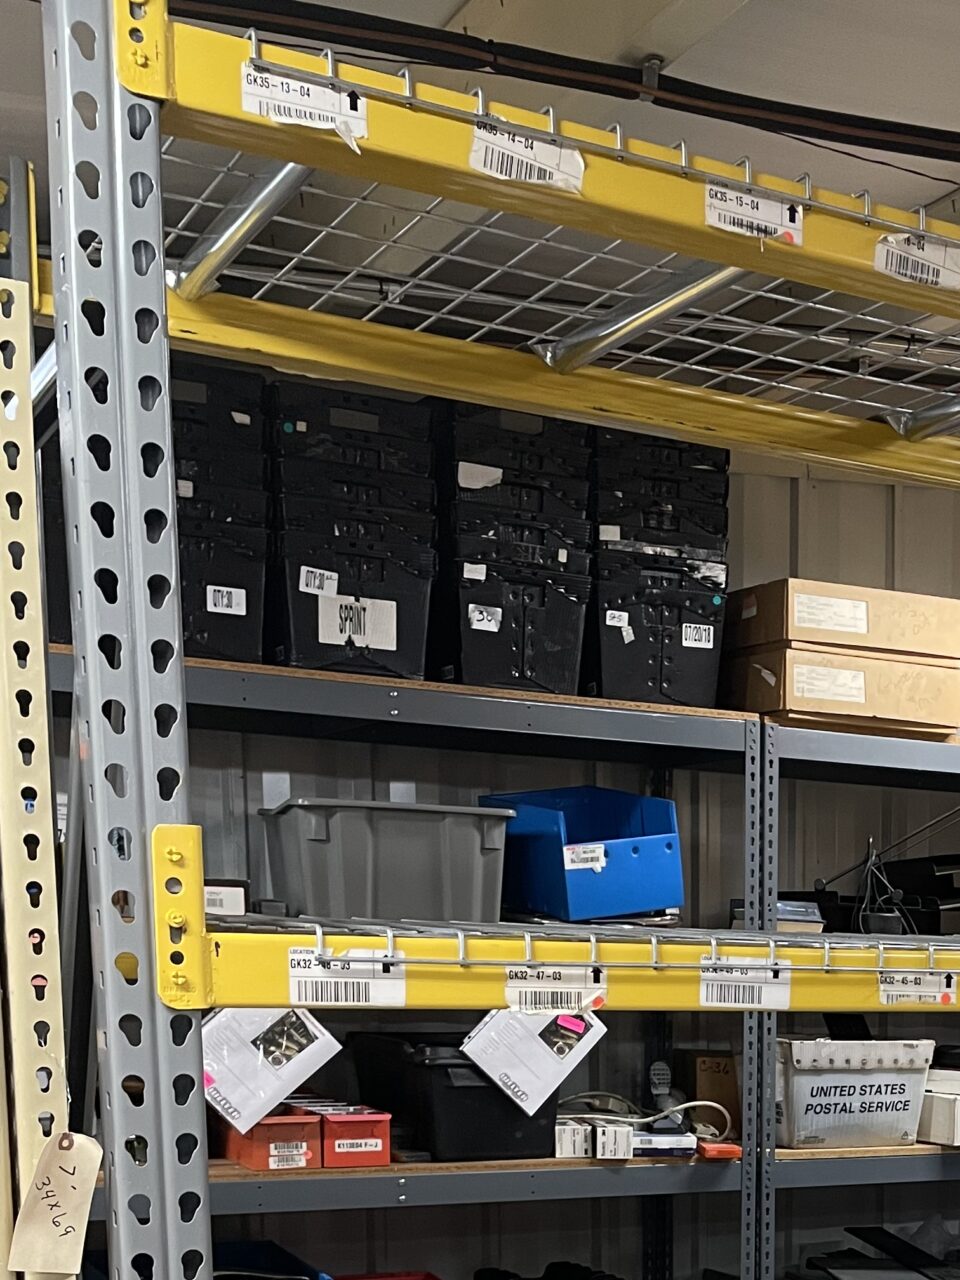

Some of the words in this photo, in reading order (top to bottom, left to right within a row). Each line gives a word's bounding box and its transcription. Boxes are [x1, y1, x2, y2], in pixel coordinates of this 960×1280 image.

[339, 603, 367, 638] SPRINT
[684, 625, 711, 644] 07/20/18
[508, 970, 562, 981] GK32-47-03
[810, 1085, 856, 1098] UNITED
[859, 1083, 906, 1096] STATES
[805, 1102, 855, 1115] POSTAL
[859, 1100, 910, 1113] SERVICE
